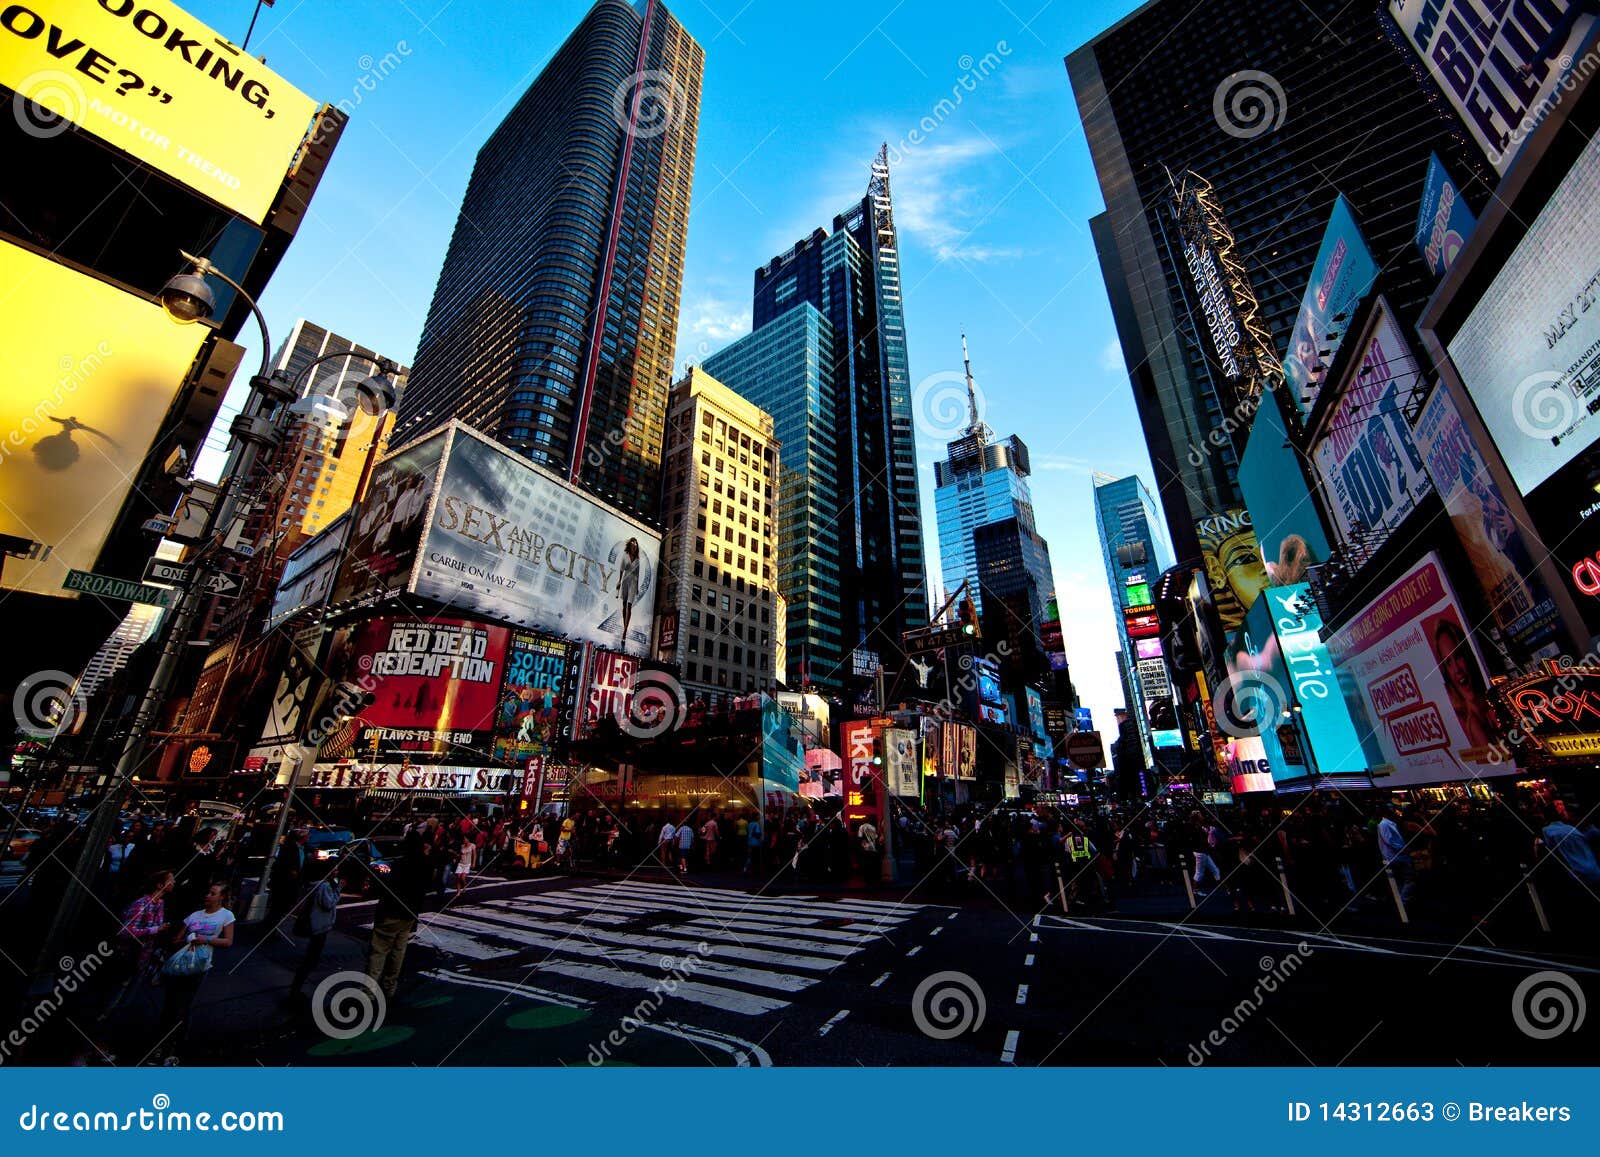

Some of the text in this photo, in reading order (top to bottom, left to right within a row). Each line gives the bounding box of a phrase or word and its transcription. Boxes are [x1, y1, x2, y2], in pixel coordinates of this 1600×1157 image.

[90, 98, 241, 191] MOTOR TREND
[1183, 241, 1239, 378] AMERICAN EAGLE
[439, 495, 616, 594] SEX AND THE CITY
[161, 567, 190, 581] ONE
[430, 552, 517, 590] CARRIE ON MAY 27
[68, 573, 154, 603] BROADWAY
[1124, 604, 1156, 615] TOSHIBA
[387, 628, 488, 660] RED DEAD
[370, 651, 496, 684] REDEMPTION
[511, 651, 565, 675] SOUTH
[1141, 671, 1166, 679] COMING
[508, 666, 563, 692] PACIFIC
[563, 650, 579, 736] PALACE
[1371, 672, 1418, 711] PROMISES
[364, 728, 473, 744] OUTLAWS TO THE END
[1392, 711, 1443, 748] PROMISES
[1549, 737, 1600, 752] DELICATE
[396, 765, 471, 789] GUEST
